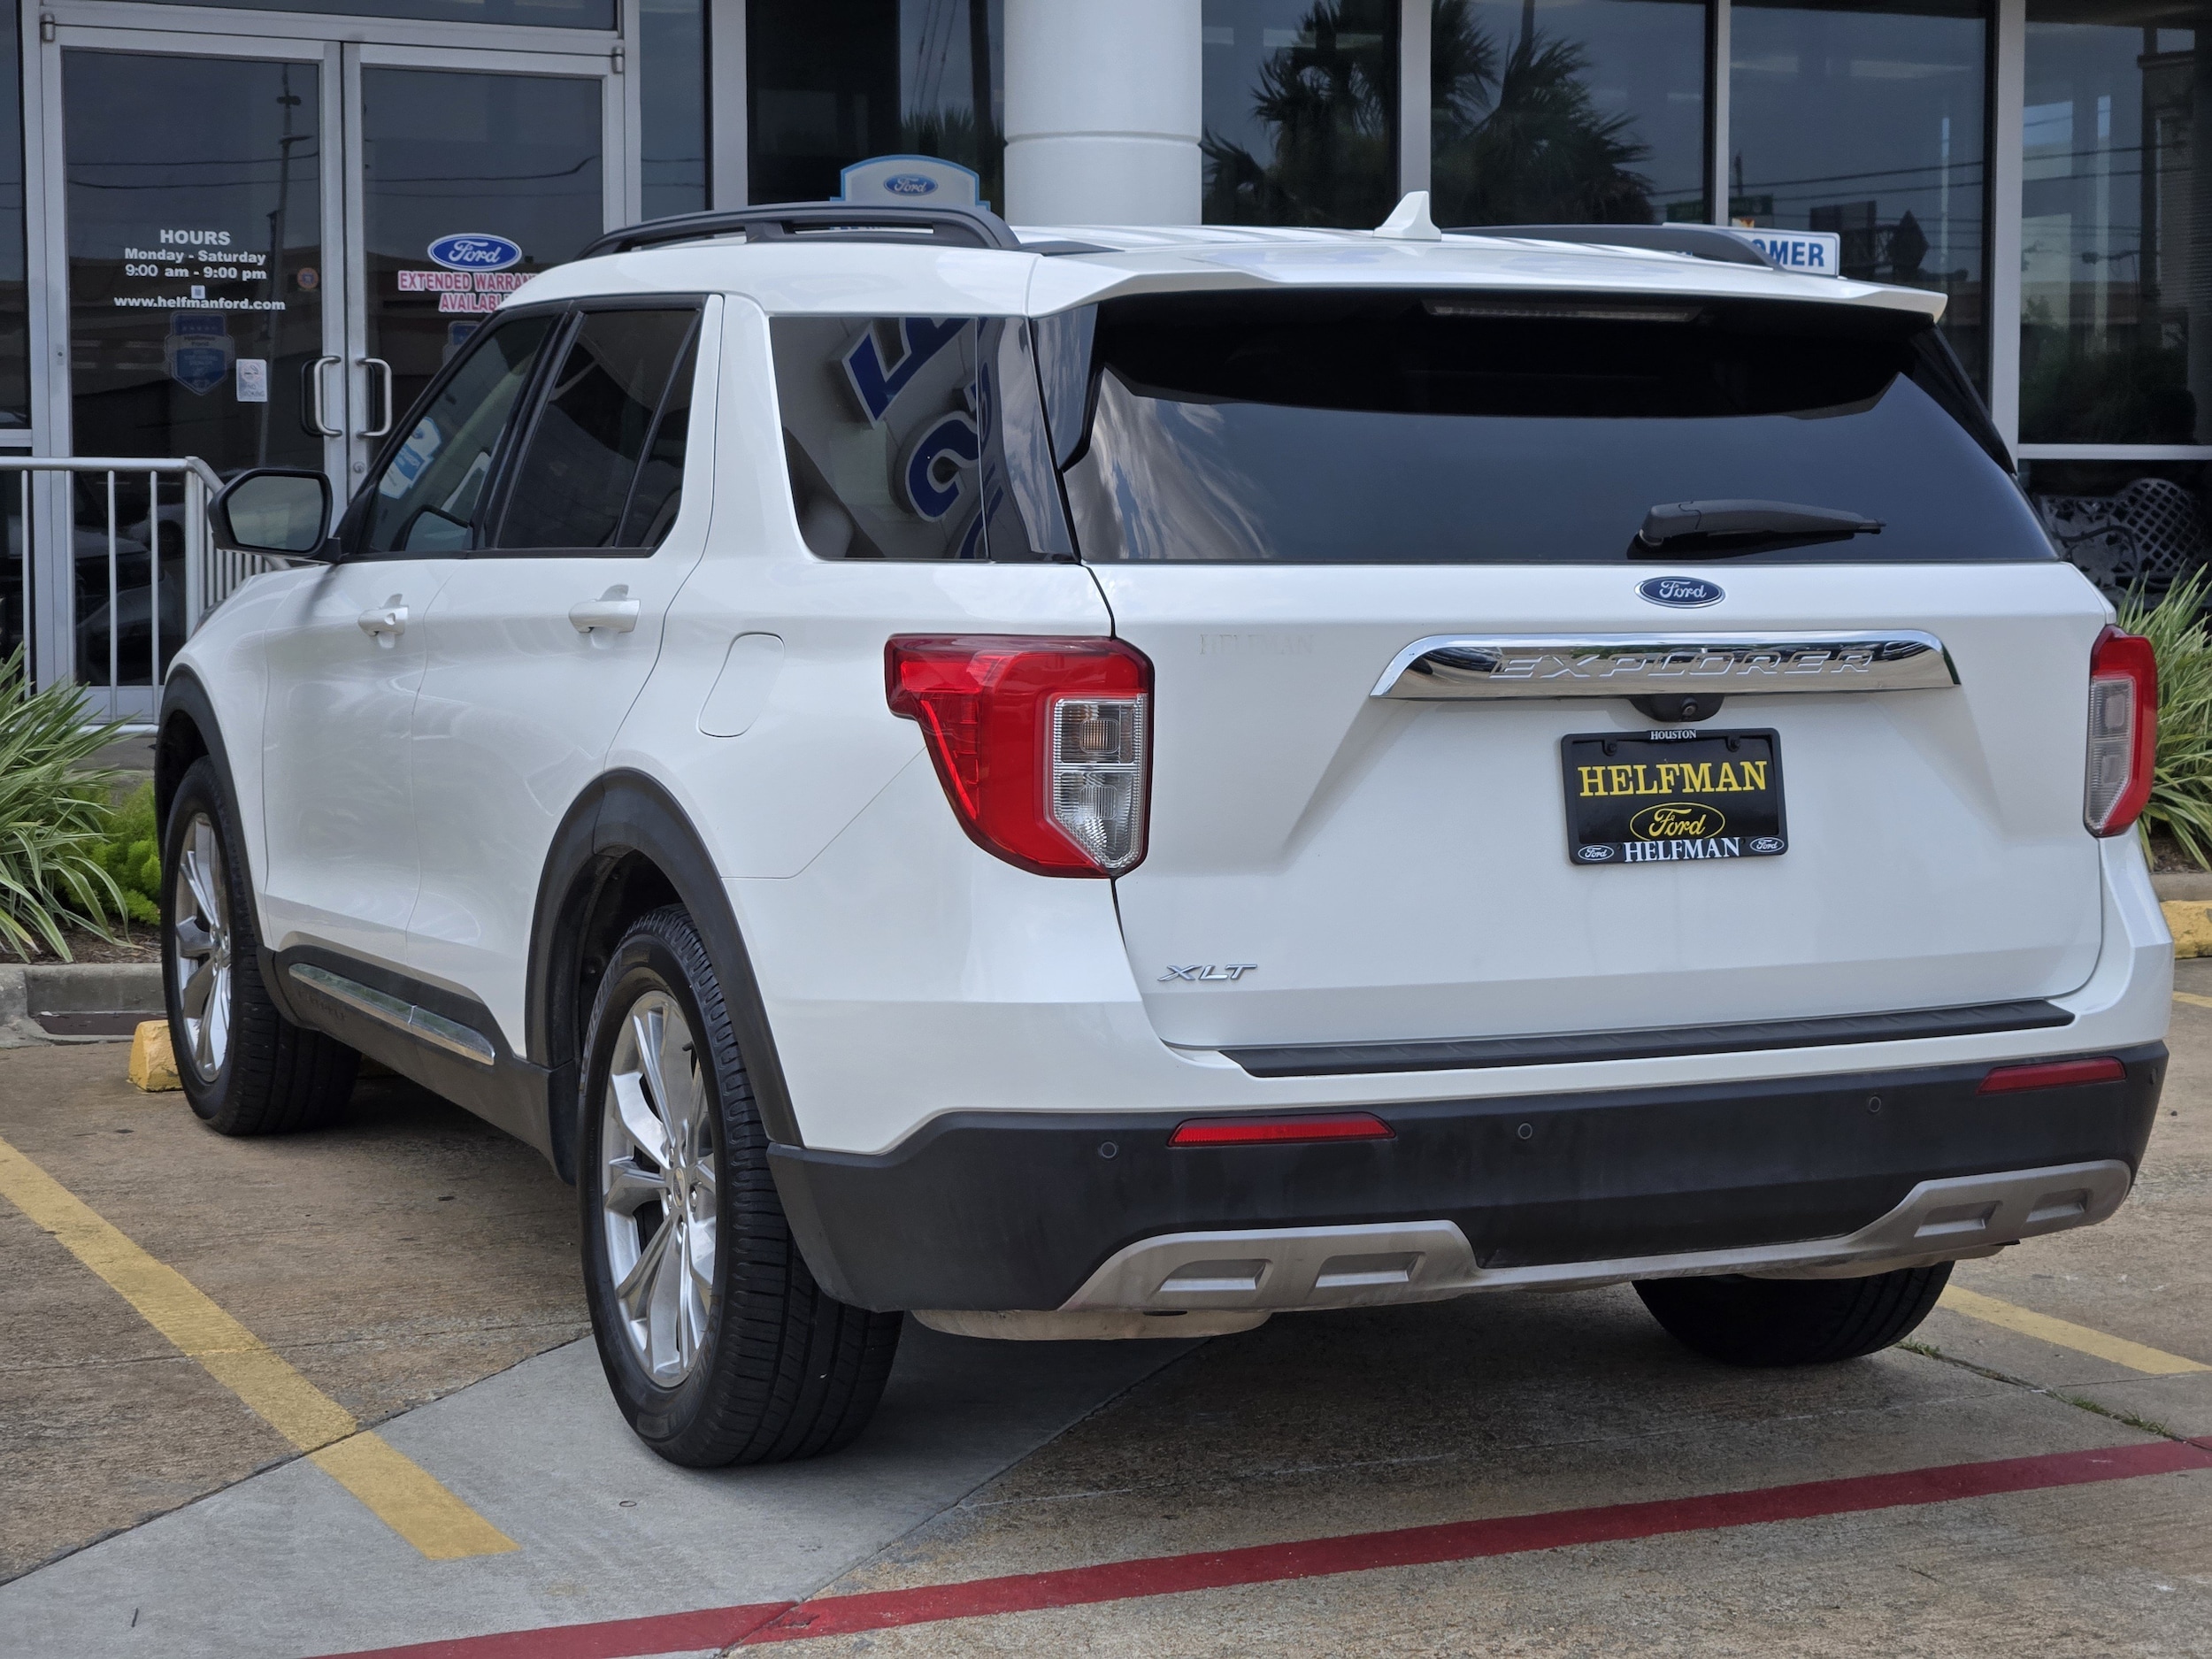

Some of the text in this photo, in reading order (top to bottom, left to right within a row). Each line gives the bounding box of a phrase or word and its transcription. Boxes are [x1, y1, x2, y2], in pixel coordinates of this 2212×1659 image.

[159, 229, 232, 246] HOURS
[125, 248, 184, 264] Monday
[197, 250, 266, 265] Saturday
[125, 264, 158, 277] 9:00
[165, 266, 189, 278] am
[203, 266, 237, 279] 9:00
[242, 269, 267, 281] pm
[399, 272, 536, 291] EXTENDED WARRA
[113, 296, 286, 311] www.helfmanford.com
[441, 294, 509, 311] AVAILAB
[1488, 649, 1875, 679] EXPLORER
[1650, 729, 1697, 741] HOUSTON
[1577, 760, 1768, 796] HELFMAN
[1647, 807, 1708, 837] Ford
[1584, 836, 1778, 863] Ford HELFMAN Ford
[1157, 964, 1257, 981] XLT
